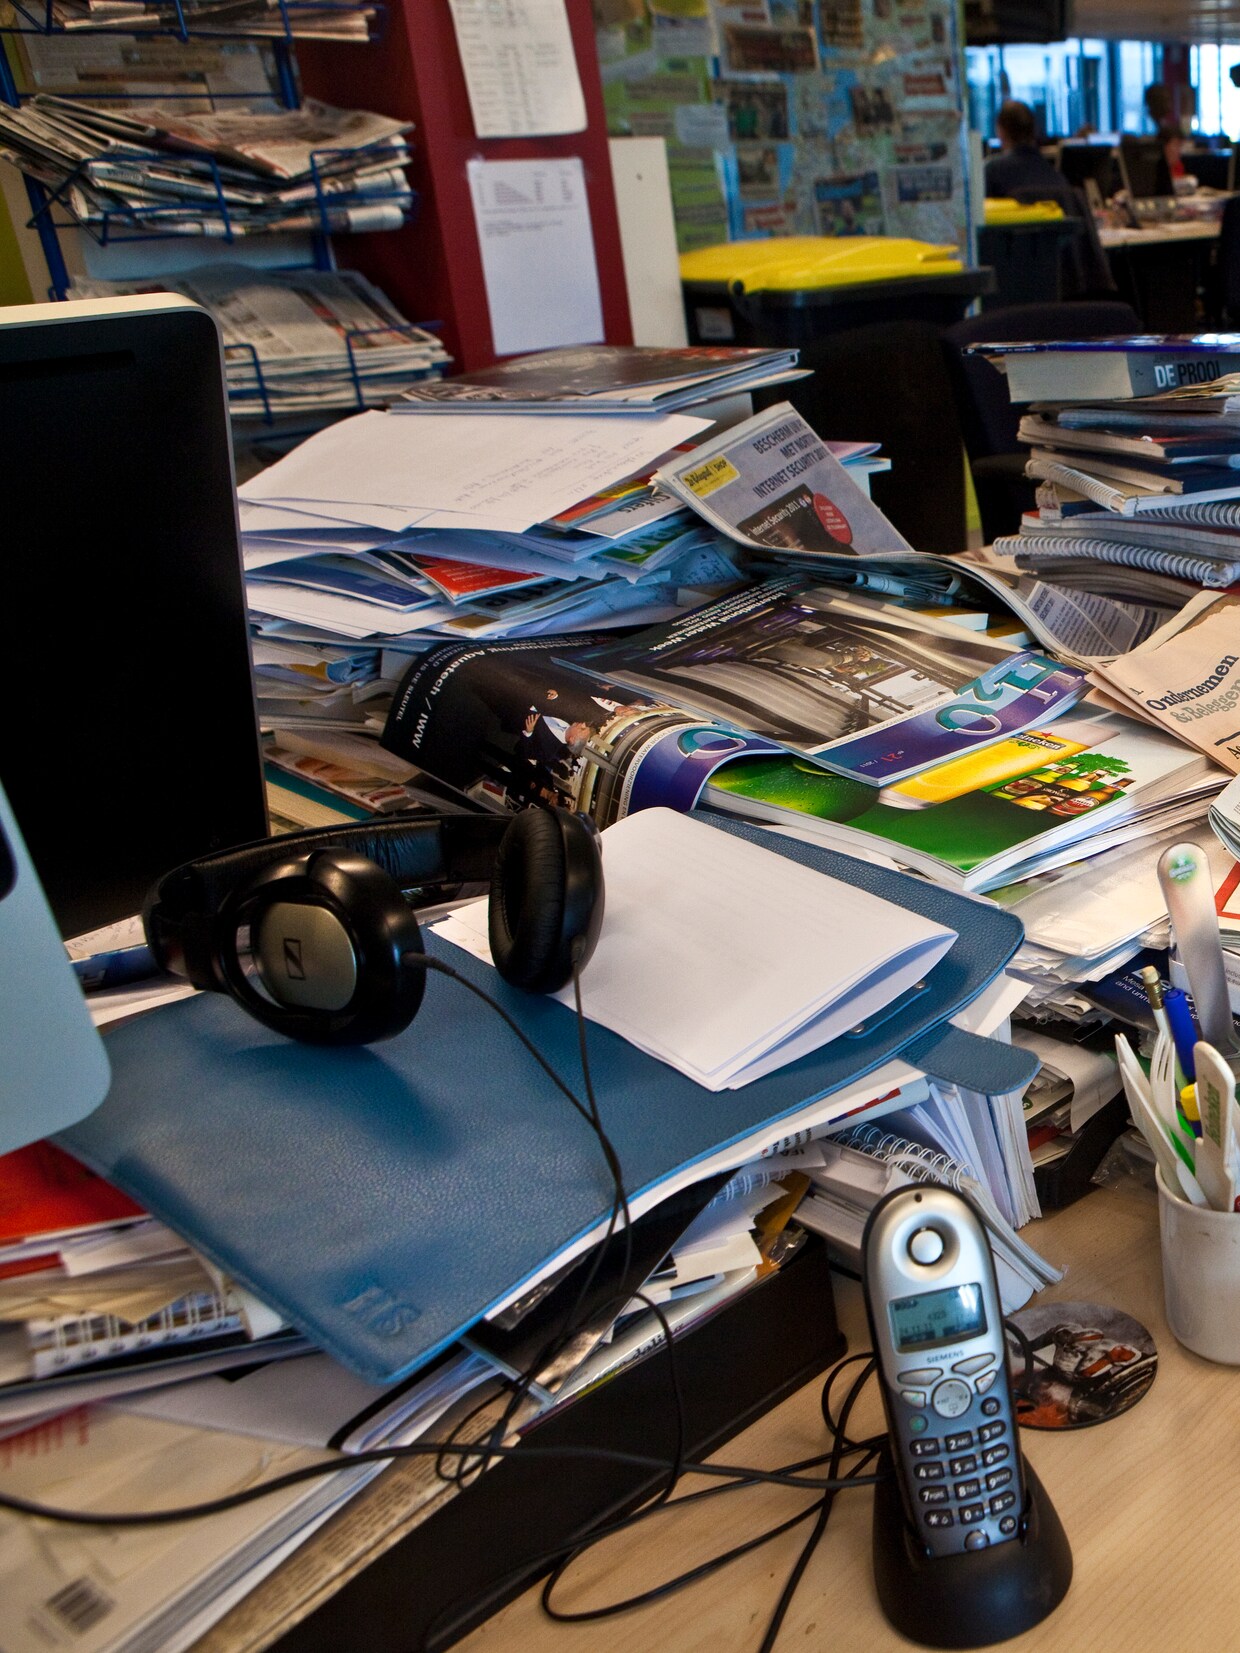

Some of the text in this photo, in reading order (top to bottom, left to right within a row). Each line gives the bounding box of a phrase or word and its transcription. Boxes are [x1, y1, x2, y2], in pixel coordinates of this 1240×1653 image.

[1154, 364, 1177, 388] DE
[753, 425, 792, 454] BESCHERM
[780, 442, 798, 459] MET
[753, 468, 791, 498] INTERNET
[770, 507, 791, 526] Security
[786, 500, 800, 515] 2011
[649, 632, 686, 656] Week
[430, 650, 485, 696] Aquatech
[1146, 653, 1239, 711] Ondernemen
[1014, 733, 1062, 751] eineken
[1115, 980, 1132, 993] and
[926, 1351, 964, 1365] SIEMENS
[983, 1428, 991, 1439] 3
[949, 1439, 957, 1450] 2
[985, 1452, 994, 1463] 6
[918, 1467, 927, 1477] 4
[953, 1462, 962, 1473] 5
[989, 1477, 997, 1488] 9
[923, 1490, 930, 1501] 7
[958, 1486, 967, 1496] 8
[964, 1509, 972, 1520] 0
